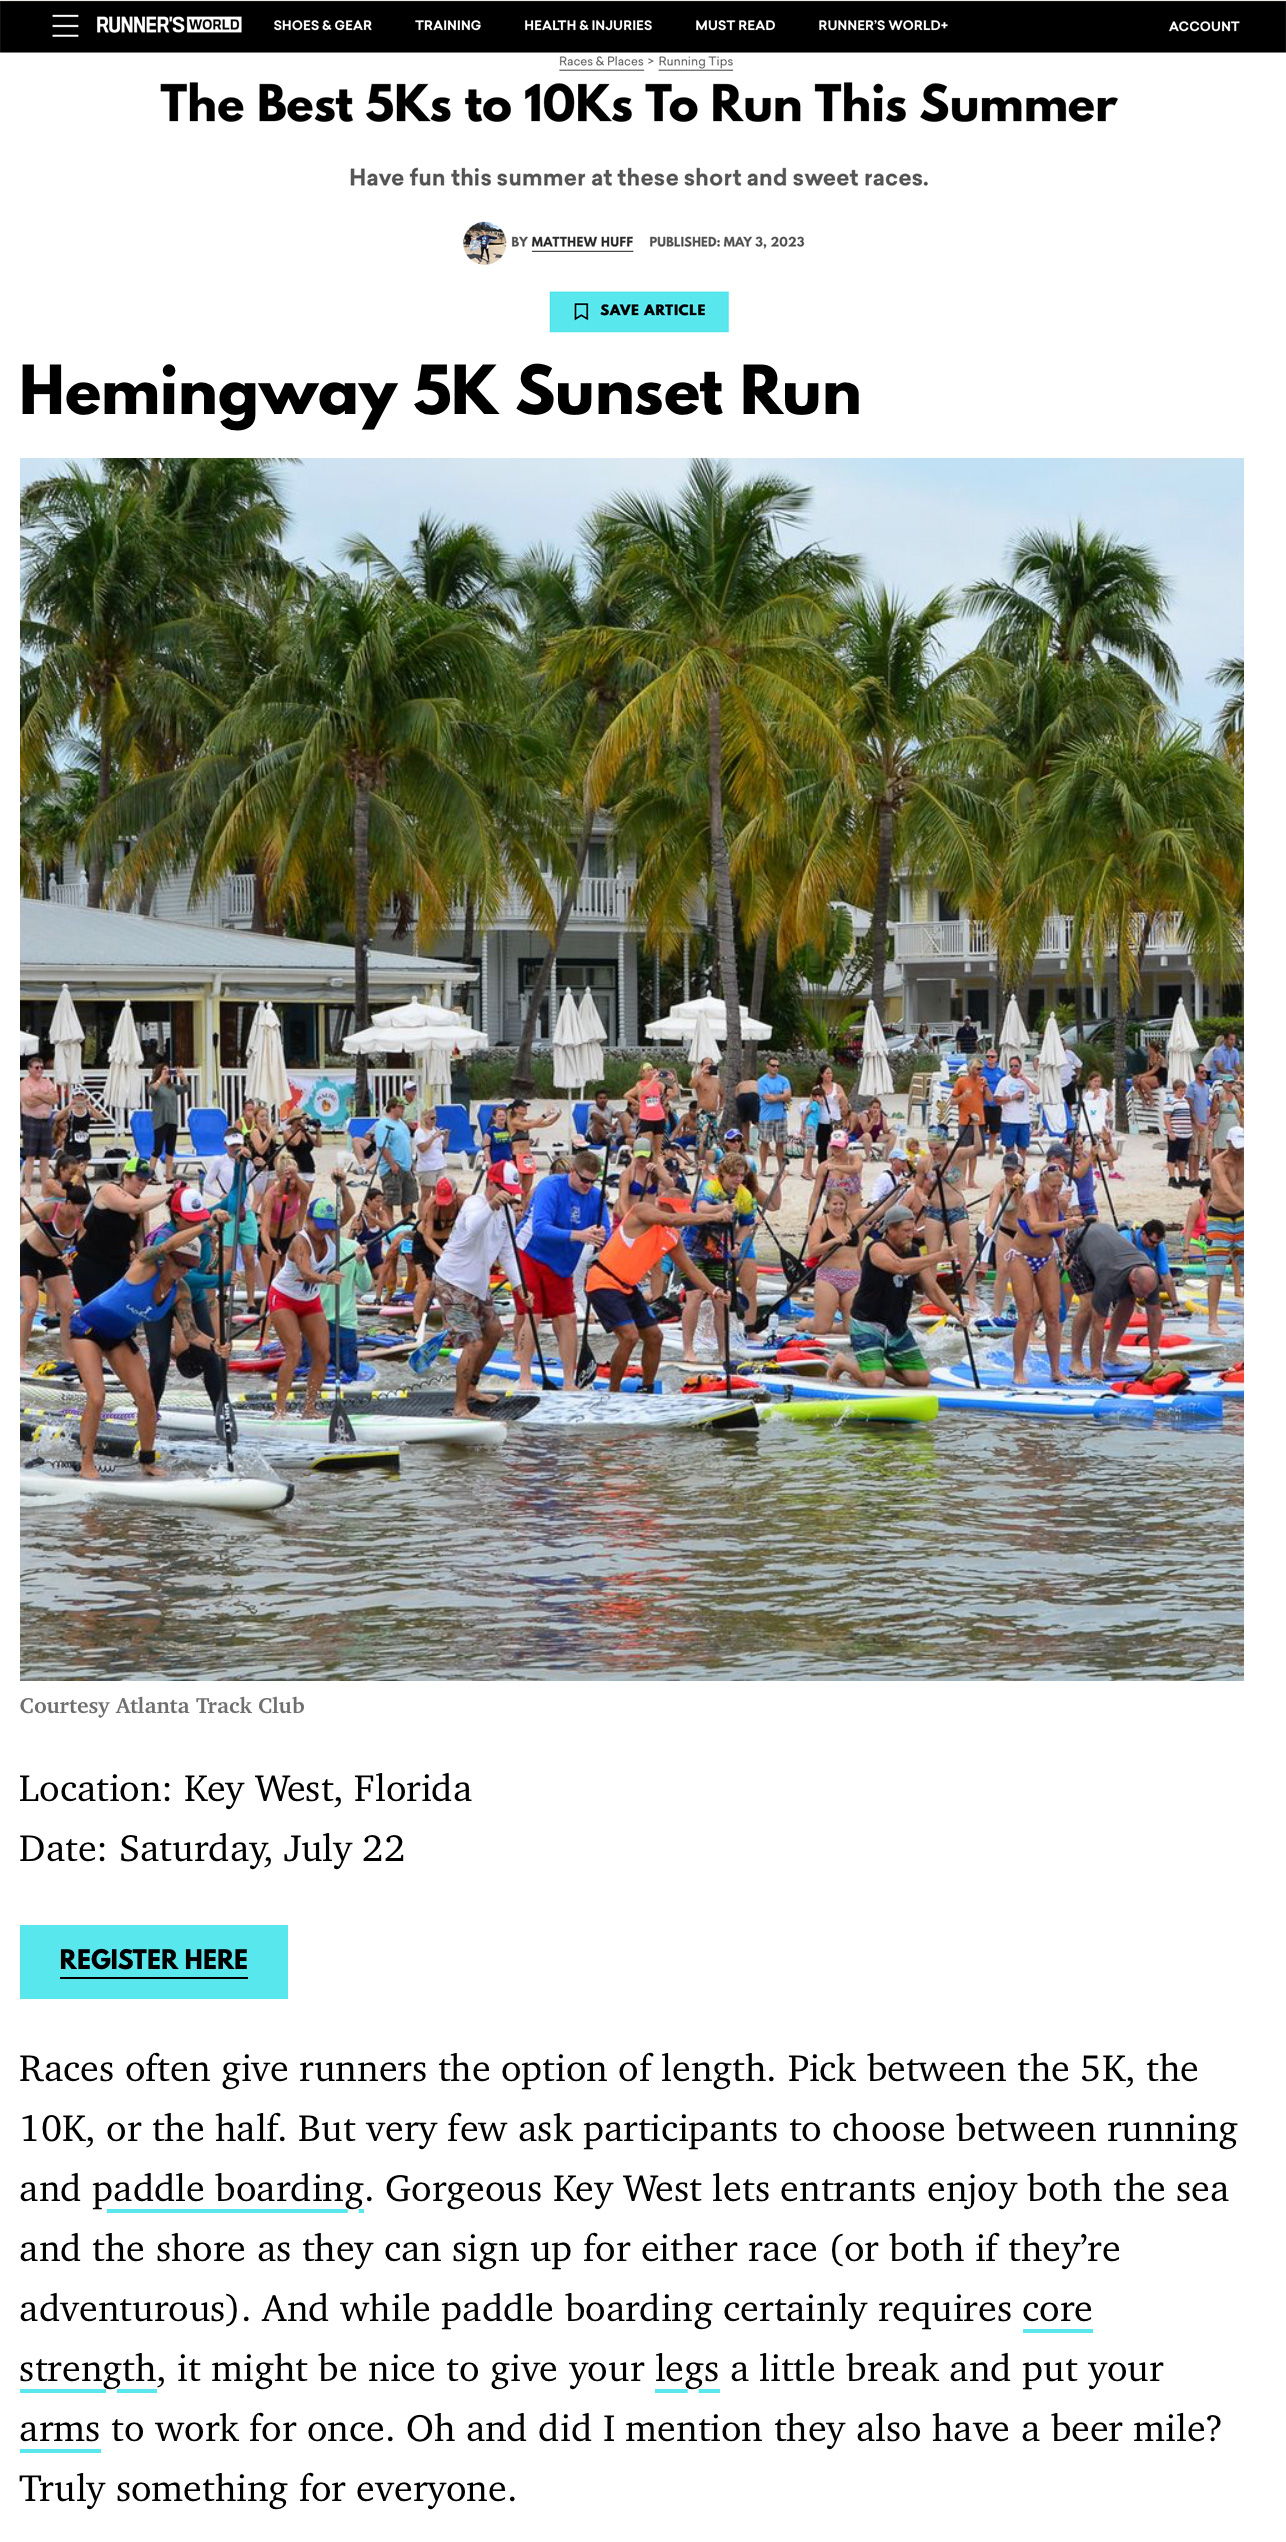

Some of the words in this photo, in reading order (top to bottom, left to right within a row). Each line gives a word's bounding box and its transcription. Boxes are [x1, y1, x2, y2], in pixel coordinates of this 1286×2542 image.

[97, 16, 184, 33] RUNNER'S
[188, 18, 240, 31] WORLD
[273, 19, 320, 31] SHOES
[322, 19, 332, 31] &
[334, 19, 372, 31] GEAR
[414, 19, 482, 31] TRAINING
[524, 19, 577, 31] HEALTH
[579, 19, 589, 31] &
[591, 19, 653, 31] INJURIES
[695, 19, 736, 31] MUST
[738, 19, 776, 31] READ
[818, 19, 886, 31] RUNNER’S
[888, 19, 949, 31] WORLD+
[1168, 20, 1241, 32] ACCOUNT
[559, 55, 593, 67] Races
[595, 55, 605, 66] &
[607, 55, 644, 67] Places
[659, 55, 706, 69] Running
[708, 55, 734, 69] Tips
[159, 81, 245, 123] The
[258, 83, 354, 123] Best
[365, 83, 452, 123] 5Ks
[464, 88, 512, 123] to
[524, 82, 633, 123] 10Ks
[644, 83, 699, 123] To
[712, 83, 802, 123] Run
[814, 81, 907, 123] This
[919, 82, 1119, 123] Summer
[350, 167, 405, 187] Have
[409, 167, 445, 187] fun
[450, 167, 492, 187] this
[496, 172, 586, 187] summer
[591, 169, 613, 187] at
[616, 167, 679, 187] these
[684, 167, 742, 187] short
[746, 167, 787, 187] and
[792, 169, 859, 187] sweet
[864, 172, 929, 187] races.
[511, 236, 529, 248] BY
[531, 236, 598, 248] MATTHEW
[600, 236, 634, 248] HUFF
[649, 235, 721, 248] PUBLISHED:
[723, 236, 753, 248] MAY
[754, 236, 767, 250] 3,
[770, 236, 805, 248] 2023
[599, 303, 640, 317] SAVE
[643, 303, 706, 317] ARTICLE
[21, 363, 399, 432] Hemingway
[413, 363, 501, 416] 5K
[515, 362, 724, 416] Sunset
[742, 363, 860, 416] Run
[19, 1697, 111, 1719] Courtesy
[115, 1696, 190, 1714] Atlanta
[195, 1696, 253, 1714] Track
[258, 1696, 305, 1714] Club
[19, 1773, 171, 1803] Location:
[184, 1774, 246, 1810] Key
[254, 1774, 342, 1808] West,
[354, 1772, 473, 1803] Florida
[19, 1834, 106, 1863] Date:
[120, 1832, 272, 1870] Saturday,
[283, 1832, 354, 1870] July
[362, 1834, 404, 1862] 22
[60, 1948, 180, 1971] REGISTER
[185, 1948, 248, 1970] HERE
[19, 2054, 114, 2083] Races
[125, 2052, 211, 2083] often
[221, 2053, 288, 2090] give
[299, 2061, 427, 2083] runners
[438, 2052, 490, 2083] the
[501, 2053, 608, 2091] option
[618, 2052, 655, 2083] of
[661, 2052, 775, 2090] length.
[788, 2052, 857, 2082] Pick
[866, 2052, 1007, 2083] between
[1017, 2052, 1069, 2083] the
[1081, 2054, 1134, 2088] 5K,
[1146, 2052, 1198, 2083] the
[21, 2114, 94, 2148] 10K,
[106, 2121, 143, 2143] or
[152, 2112, 204, 2143] the
[215, 2112, 286, 2142] half.
[298, 2114, 357, 2143] But
[365, 2121, 439, 2150] very
[447, 2112, 509, 2143] few
[518, 2112, 574, 2143] ask
[583, 2113, 778, 2151] participants
[789, 2118, 821, 2143] to
[832, 2112, 945, 2143] choose
[955, 2112, 1097, 2143] between
[1107, 2113, 1239, 2150] running
[19, 2172, 81, 2203] and
[92, 2172, 204, 2211] paddle
[214, 2172, 373, 2210] boarding.
[385, 2174, 542, 2210] Gorgeous
[553, 2174, 615, 2210] Key
[622, 2174, 703, 2203] West
[712, 2172, 770, 2203] lets
[780, 2178, 916, 2203] entrants
[927, 2173, 1019, 2210] enjoy
[1026, 2172, 1103, 2203] both
[1113, 2172, 1165, 2203] the
[1176, 2181, 1230, 2203] sea
[19, 2232, 81, 2263] and
[92, 2232, 144, 2263] the
[156, 2232, 245, 2263] shore
[257, 2241, 291, 2263] as
[302, 2232, 375, 2270] they
[384, 2241, 442, 2262] can
[452, 2233, 520, 2270] sign
[530, 2241, 572, 2271] up
[583, 2232, 632, 2263] for
[641, 2232, 739, 2263] either
[748, 2241, 817, 2263] race
[831, 2233, 880, 2267] (or
[888, 2232, 965, 2263] both
[975, 2232, 1001, 2262] if
[1008, 2232, 1120, 2270] they’re
[19, 2292, 250, 2327] adventurous).
[260, 2292, 329, 2323] And
[339, 2292, 430, 2323] while
[441, 2292, 553, 2331] paddle
[564, 2292, 714, 2330] boarding
[723, 2292, 869, 2330] certainly
[878, 2293, 1012, 2331] requires
[1022, 2301, 1092, 2323] core
[19, 2352, 165, 2390] strength,
[177, 2353, 202, 2382] it
[211, 2352, 309, 2390] might
[317, 2352, 357, 2383] be
[368, 2353, 435, 2383] nice
[446, 2358, 479, 2383] to
[490, 2353, 557, 2390] give
[568, 2361, 646, 2390] your
[655, 2352, 719, 2391] legs
[730, 2361, 750, 2382] a
[759, 2352, 835, 2383] little
[845, 2352, 940, 2383] break
[949, 2352, 1011, 2383] and
[1022, 2358, 1079, 2391] put
[1087, 2361, 1165, 2390] your
[19, 2421, 100, 2443] arms
[111, 2418, 144, 2443] to
[154, 2412, 240, 2443] work
[249, 2412, 298, 2443] for
[307, 2421, 394, 2443] once.
[406, 2412, 456, 2443] Oh
[466, 2412, 527, 2443] and
[538, 2412, 592, 2443] did
[603, 2414, 615, 2442] I
[625, 2413, 763, 2443] mention
[774, 2412, 847, 2450] they
[856, 2412, 921, 2443] also
[932, 2412, 1009, 2443] have
[1021, 2421, 1041, 2442] a
[1050, 2412, 1124, 2443] beer
[1133, 2412, 1222, 2443] mile?
[18, 2472, 107, 2510] Truly
[116, 2472, 289, 2511] something
[299, 2472, 347, 2503] for
[356, 2481, 516, 2510] everyone.
